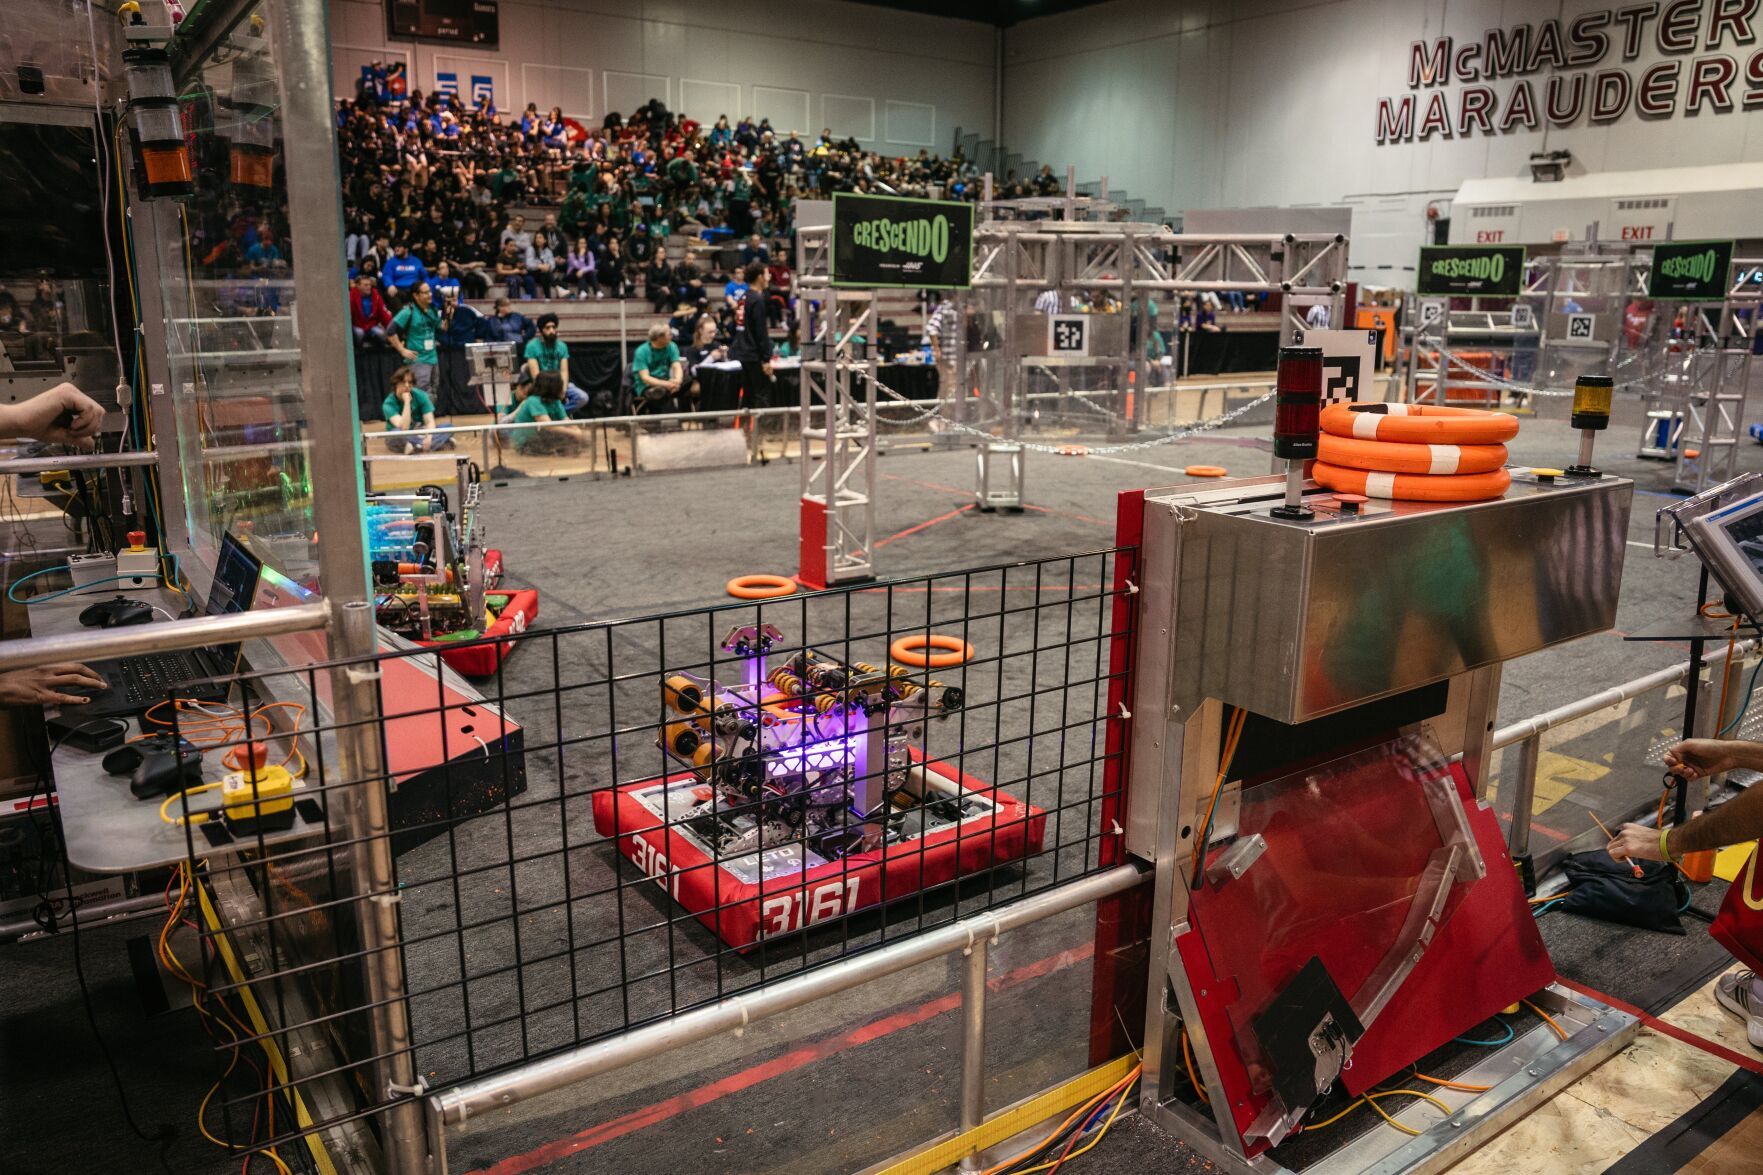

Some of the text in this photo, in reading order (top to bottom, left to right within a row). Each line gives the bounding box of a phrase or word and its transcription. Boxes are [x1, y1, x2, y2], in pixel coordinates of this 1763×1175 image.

[1408, 0, 1758, 86] McMASTER
[853, 214, 949, 263] CRESCENDO
[1476, 231, 1505, 243] EXIT
[1621, 226, 1654, 240] EXIT
[1432, 253, 1505, 283] CRESCENDO
[1661, 249, 1716, 283] CRESCENDO
[755, 876, 860, 942] 3161
